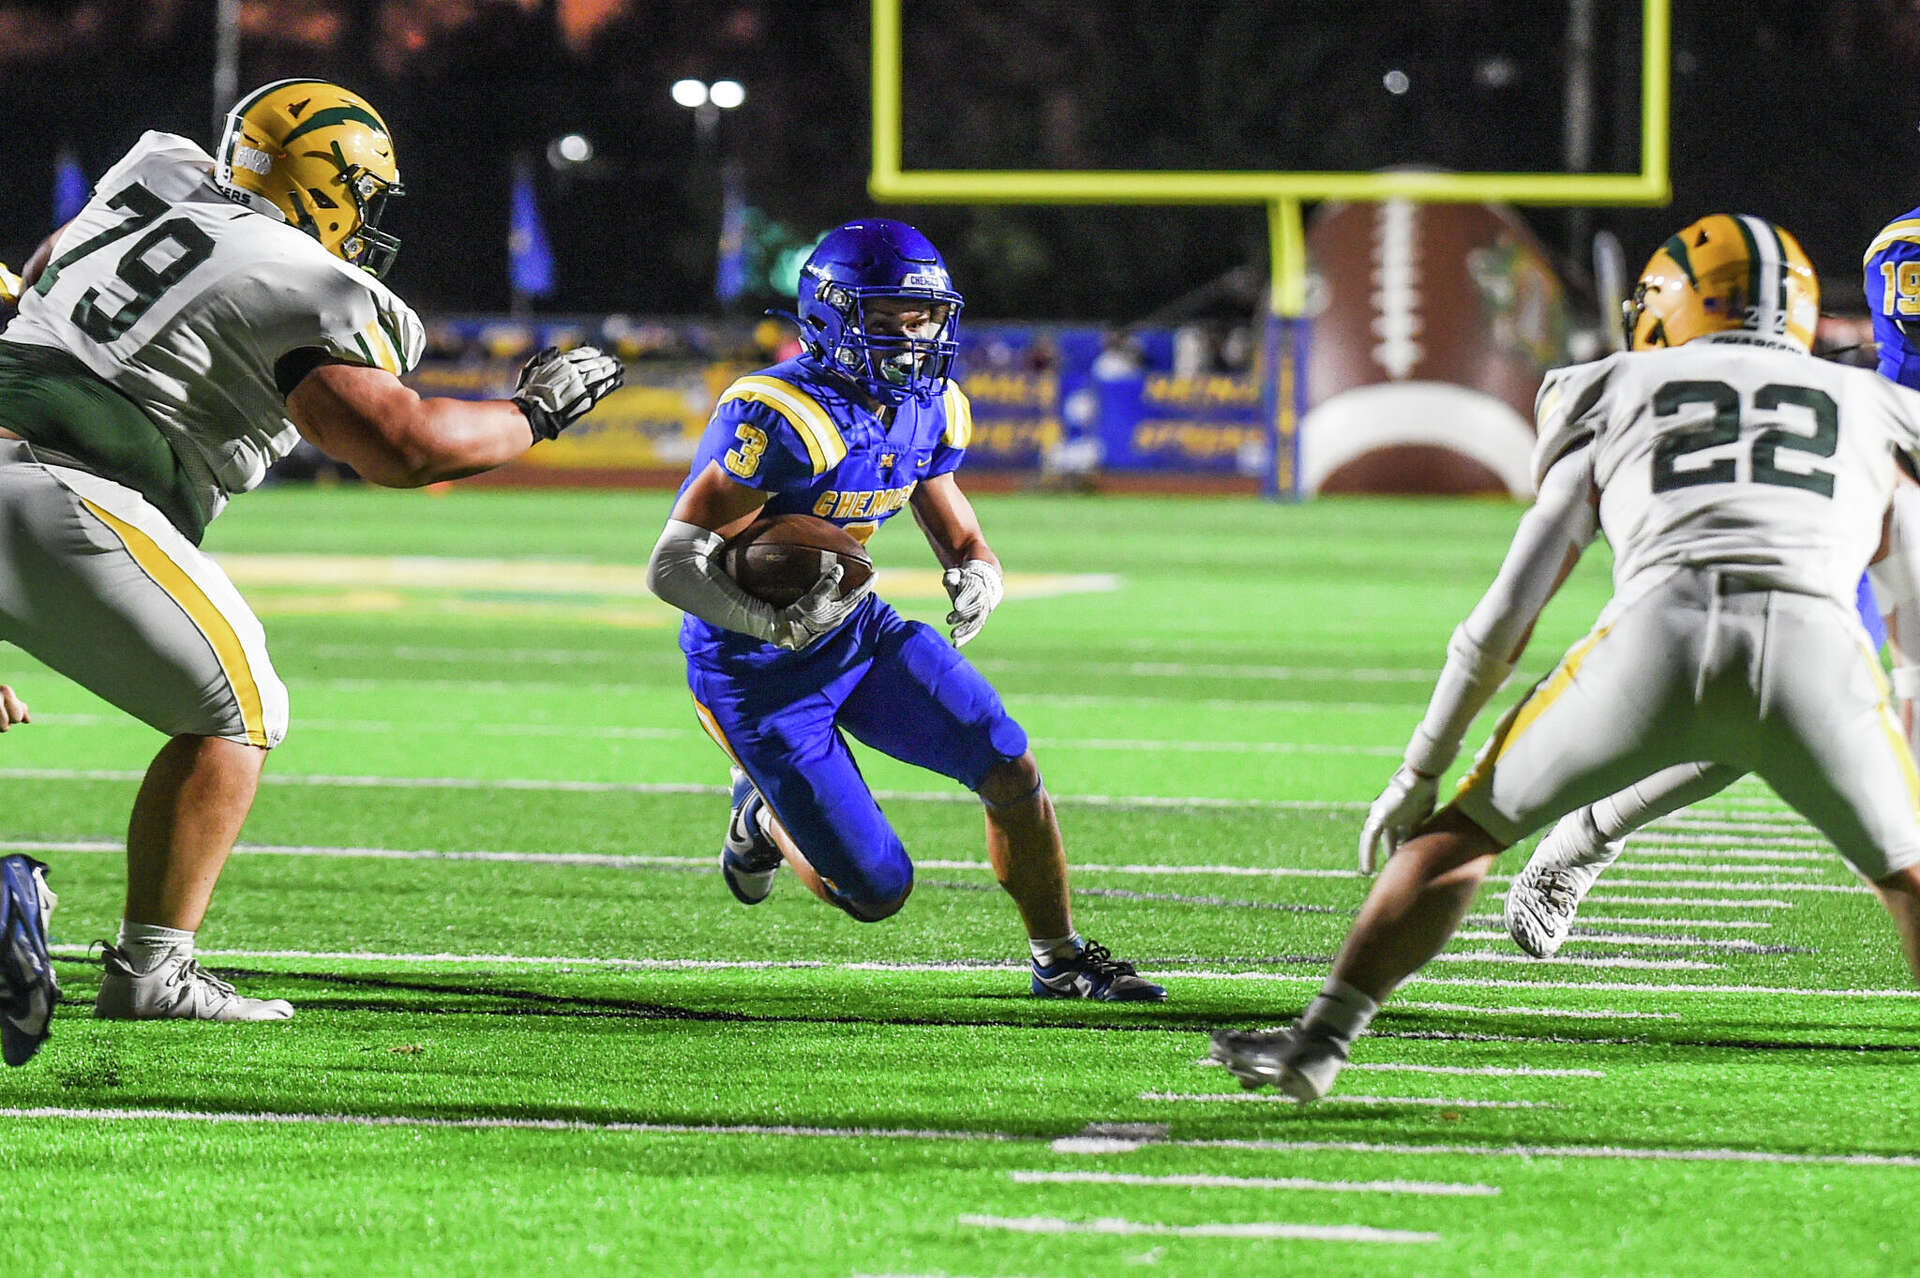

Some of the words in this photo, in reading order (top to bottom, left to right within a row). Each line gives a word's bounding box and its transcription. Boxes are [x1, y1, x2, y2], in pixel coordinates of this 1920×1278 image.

[34, 181, 216, 344] 79
[1880, 261, 1920, 316] 19
[724, 423, 768, 478] 3
[1651, 380, 1838, 500] 22
